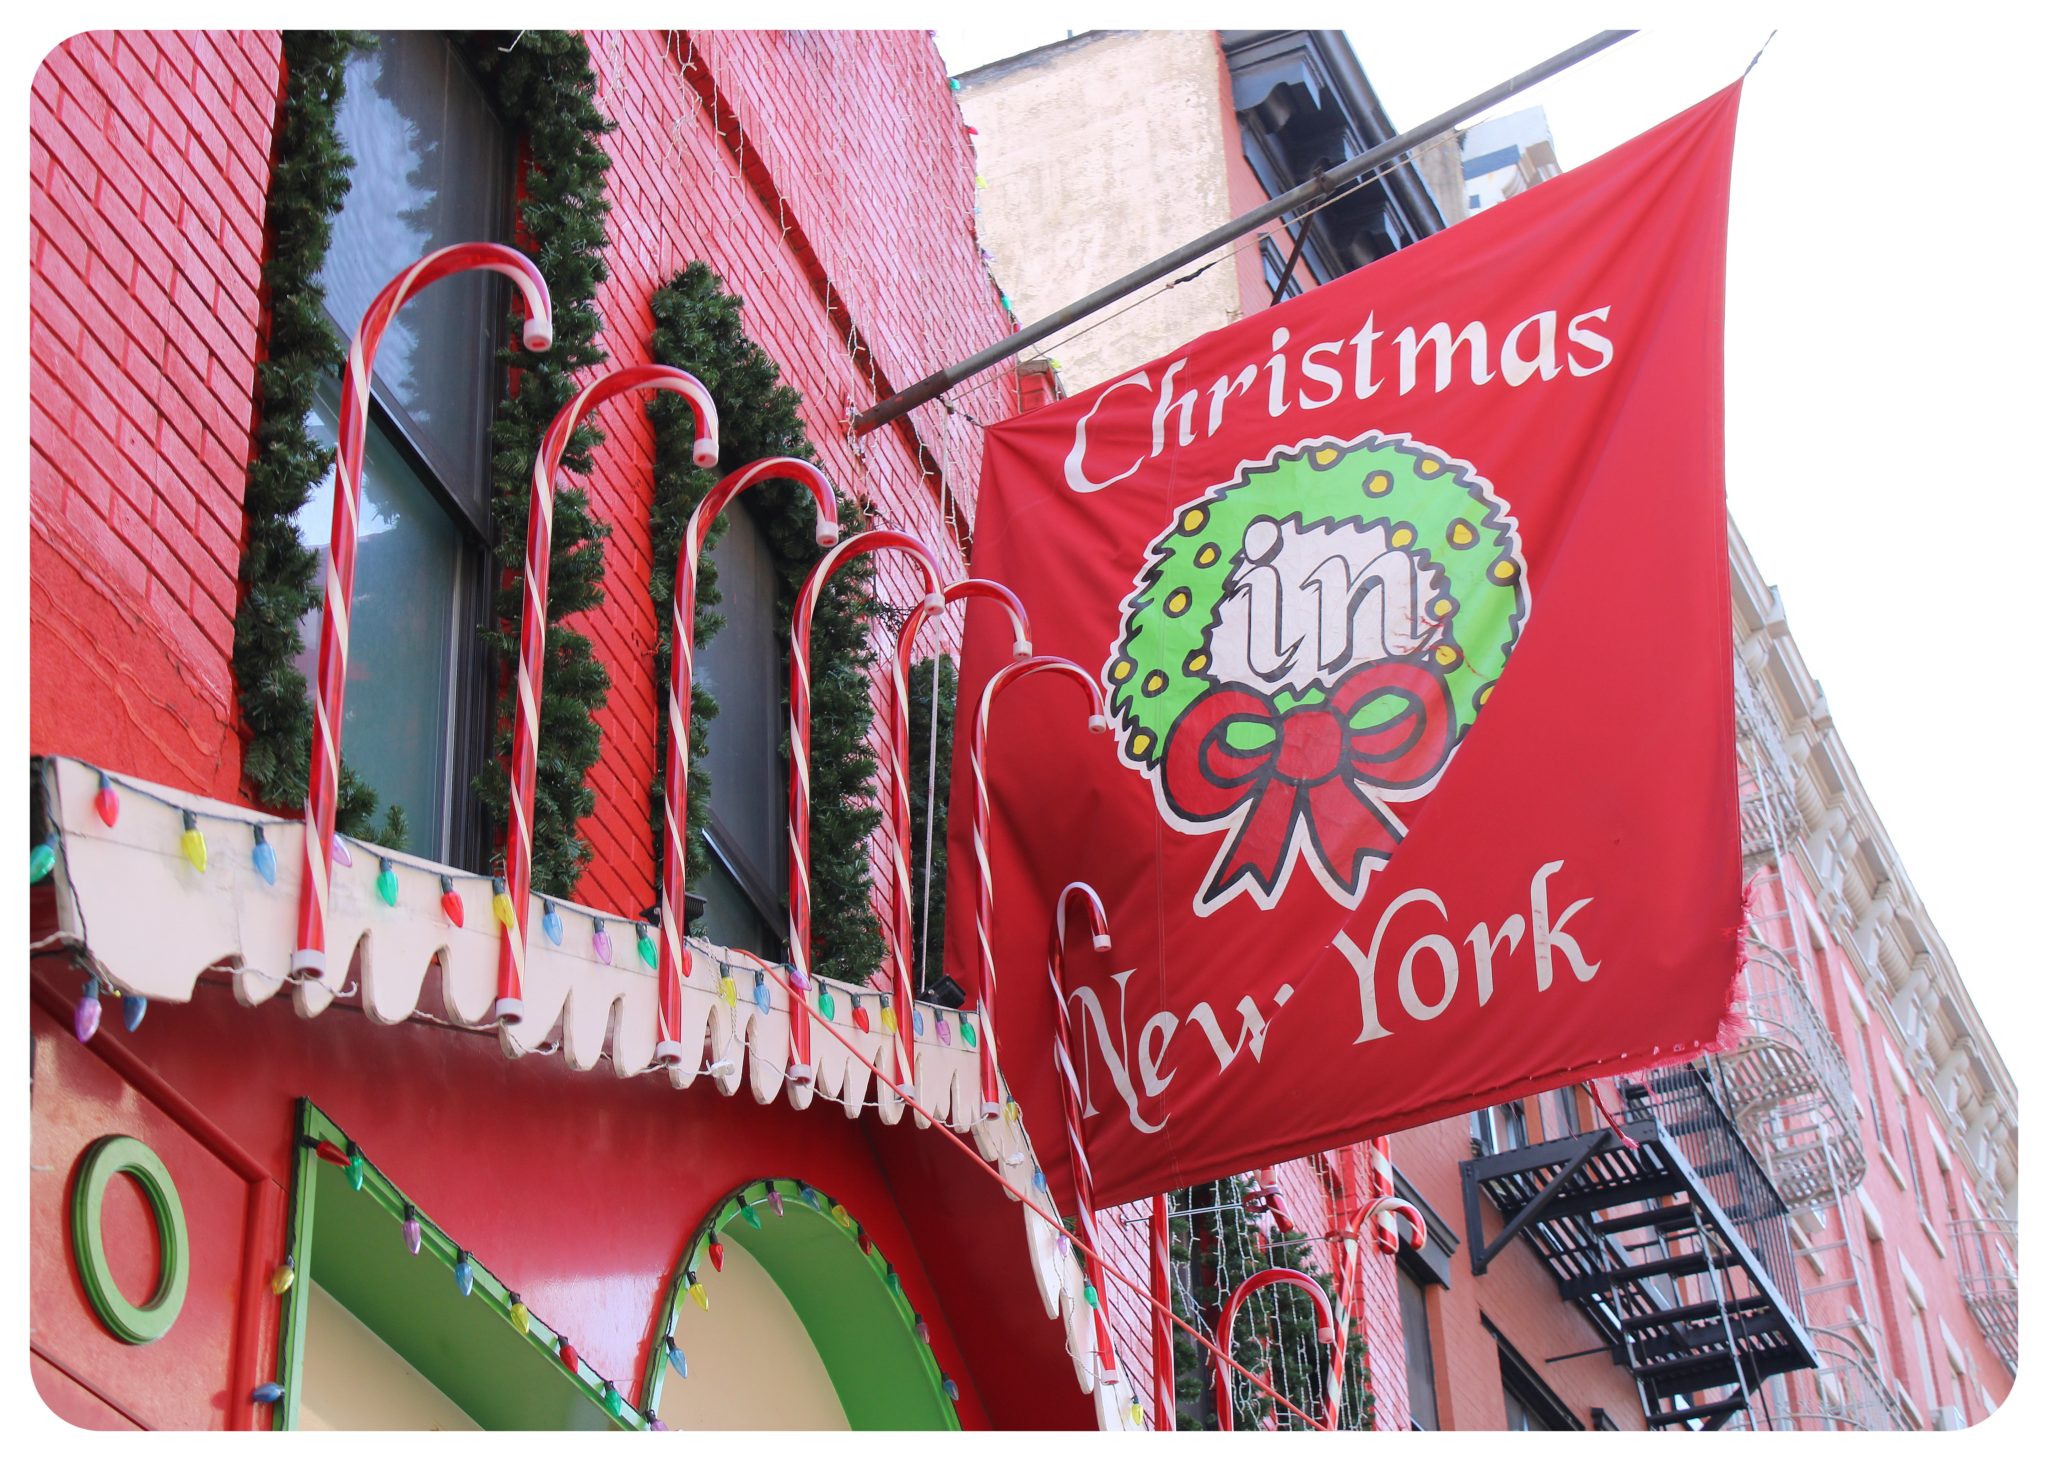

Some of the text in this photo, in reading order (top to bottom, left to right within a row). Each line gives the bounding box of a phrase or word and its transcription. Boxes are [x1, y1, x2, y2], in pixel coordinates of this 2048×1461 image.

[1064, 305, 1615, 493] Christmas
[1231, 516, 1442, 683] in
[1067, 860, 1602, 1135] New York
